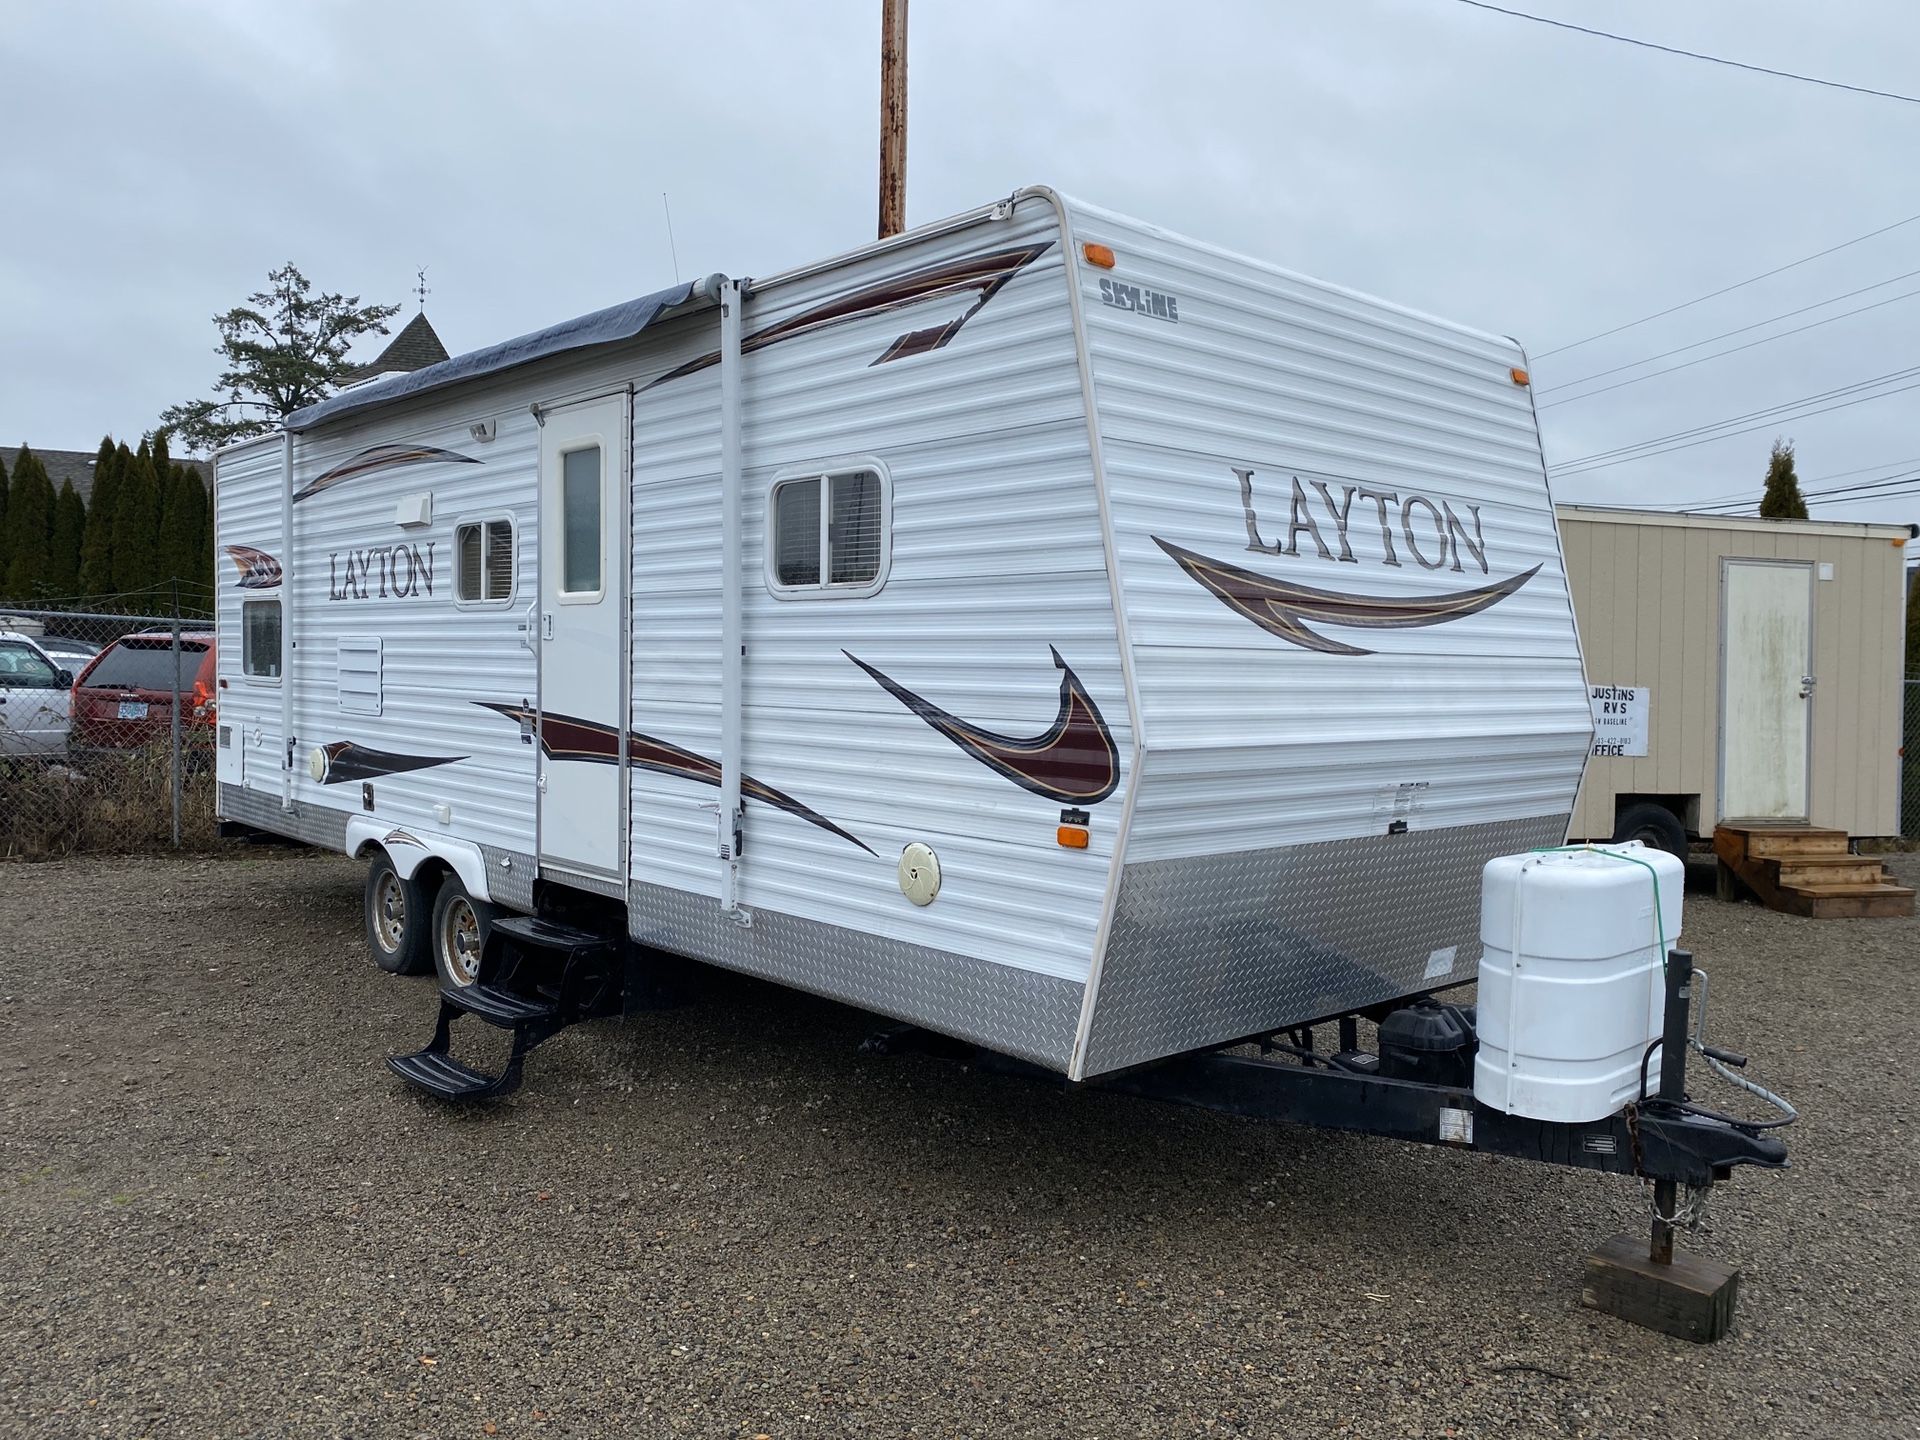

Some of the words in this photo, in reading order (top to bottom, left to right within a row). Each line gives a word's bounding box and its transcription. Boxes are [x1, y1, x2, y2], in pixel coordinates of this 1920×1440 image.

[1231, 467, 1489, 575] LAYTON
[329, 542, 436, 601] LAYTON
[1603, 702, 1627, 713] RVS
